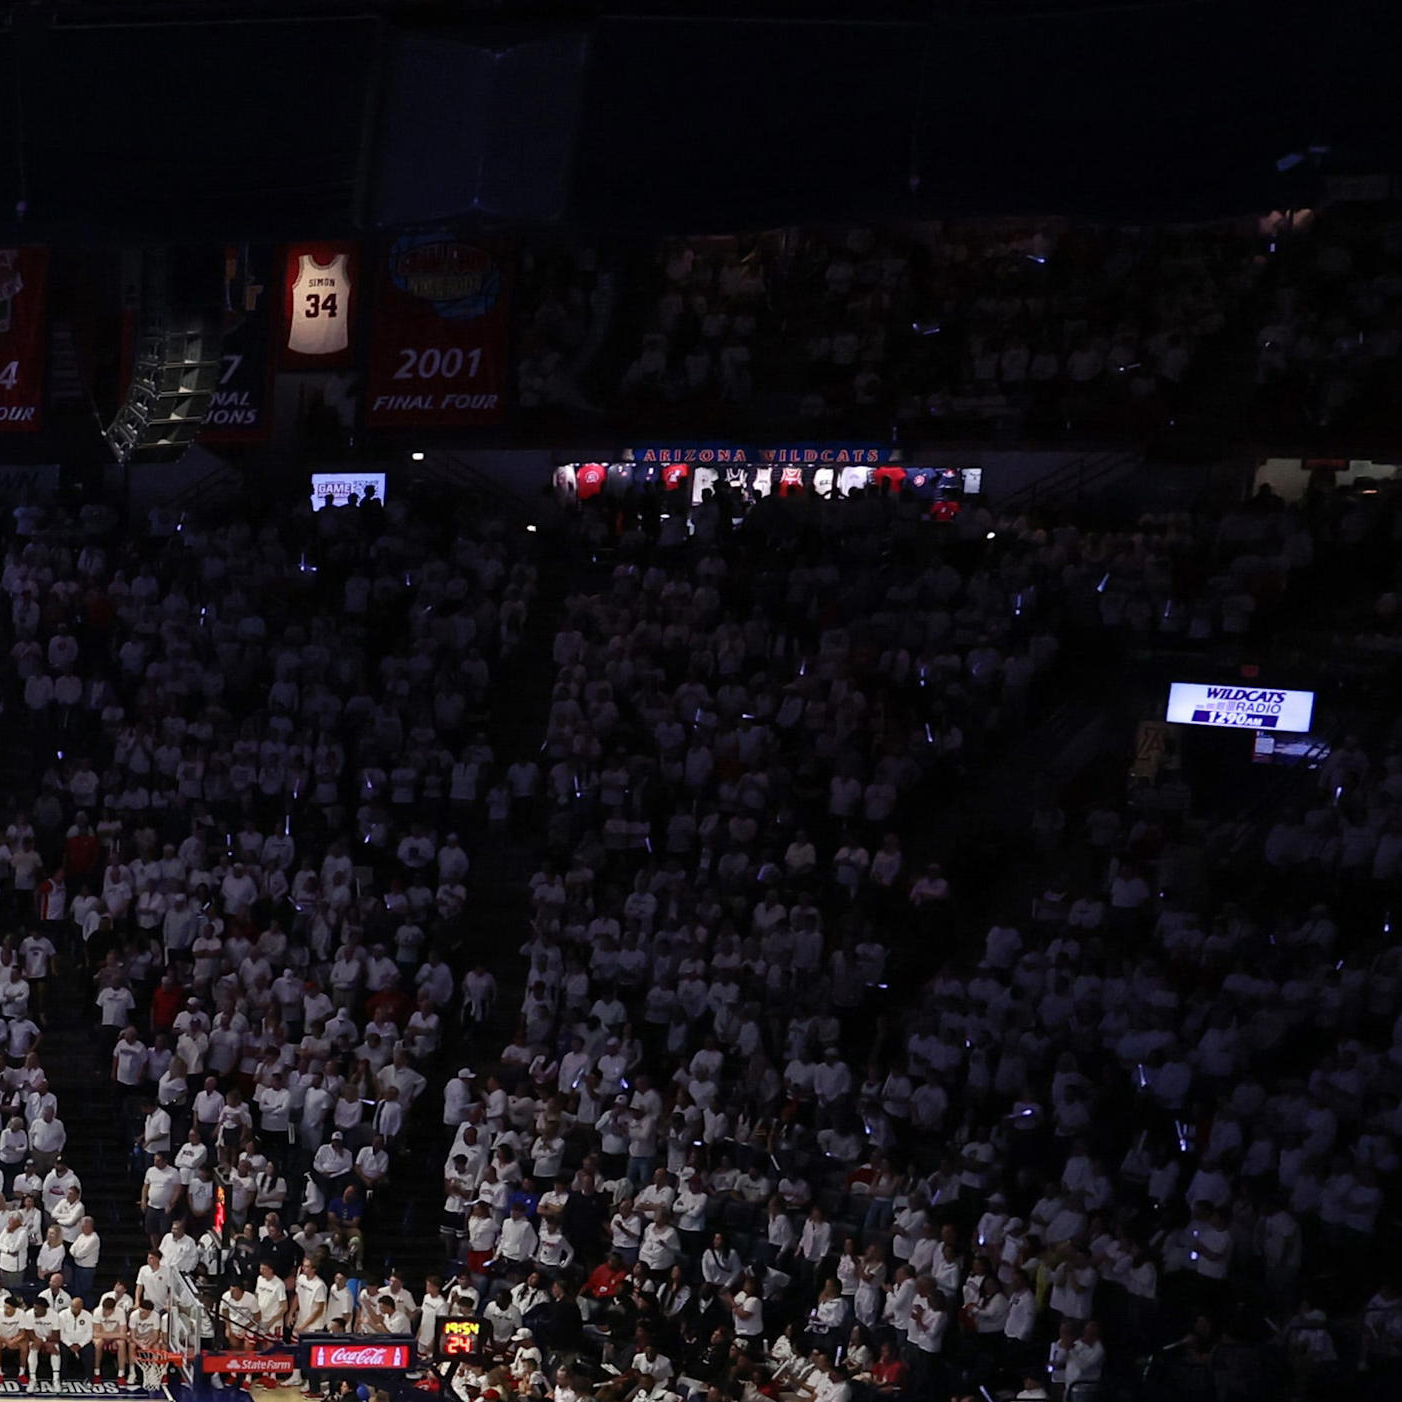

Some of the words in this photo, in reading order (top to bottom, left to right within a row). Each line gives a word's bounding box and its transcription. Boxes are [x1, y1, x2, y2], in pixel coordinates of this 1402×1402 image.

[308, 278, 335, 288] SIMON
[305, 293, 337, 318] 34
[393, 347, 483, 380] 2001
[373, 394, 436, 411] FINAL
[442, 392, 498, 411] FOUR
[643, 449, 747, 462] ARIZONA
[1207, 687, 1287, 704] WILDCATS
[1236, 702, 1282, 715] RADIO
[444, 1322, 479, 1335] 19:54
[447, 1336, 472, 1354] 24
